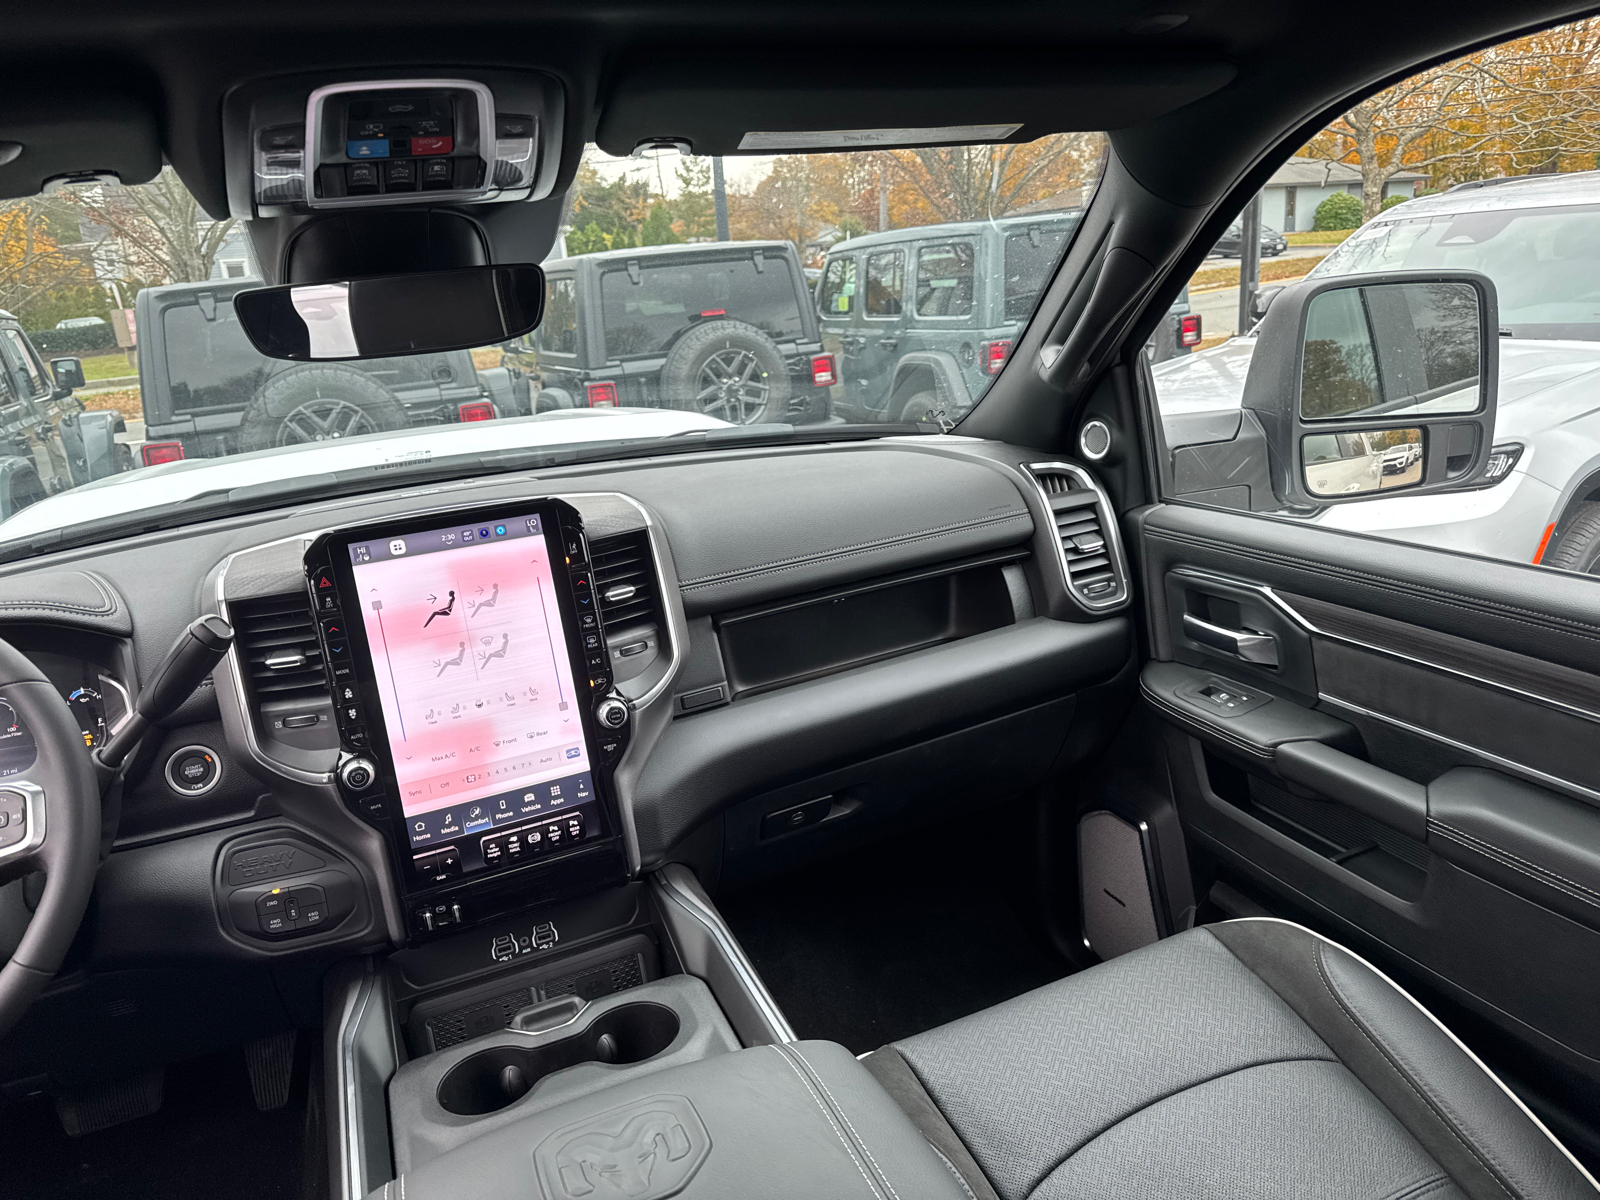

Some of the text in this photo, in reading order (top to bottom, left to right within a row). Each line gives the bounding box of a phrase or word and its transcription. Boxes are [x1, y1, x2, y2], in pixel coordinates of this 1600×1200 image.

[526, 519, 537, 527] LO
[441, 533, 456, 542] 2:30
[356, 546, 366, 555] HI
[444, 752, 456, 760] A/C
[550, 797, 564, 806] Apps
[521, 803, 542, 814] Vehicle
[496, 810, 514, 820] Phone
[466, 816, 490, 828] Comfort
[441, 826, 459, 834] Media
[548, 830, 562, 838] FRONT
[413, 833, 431, 842] Home
[234, 850, 296, 870] HEAVY
[242, 860, 294, 878] DUTY
